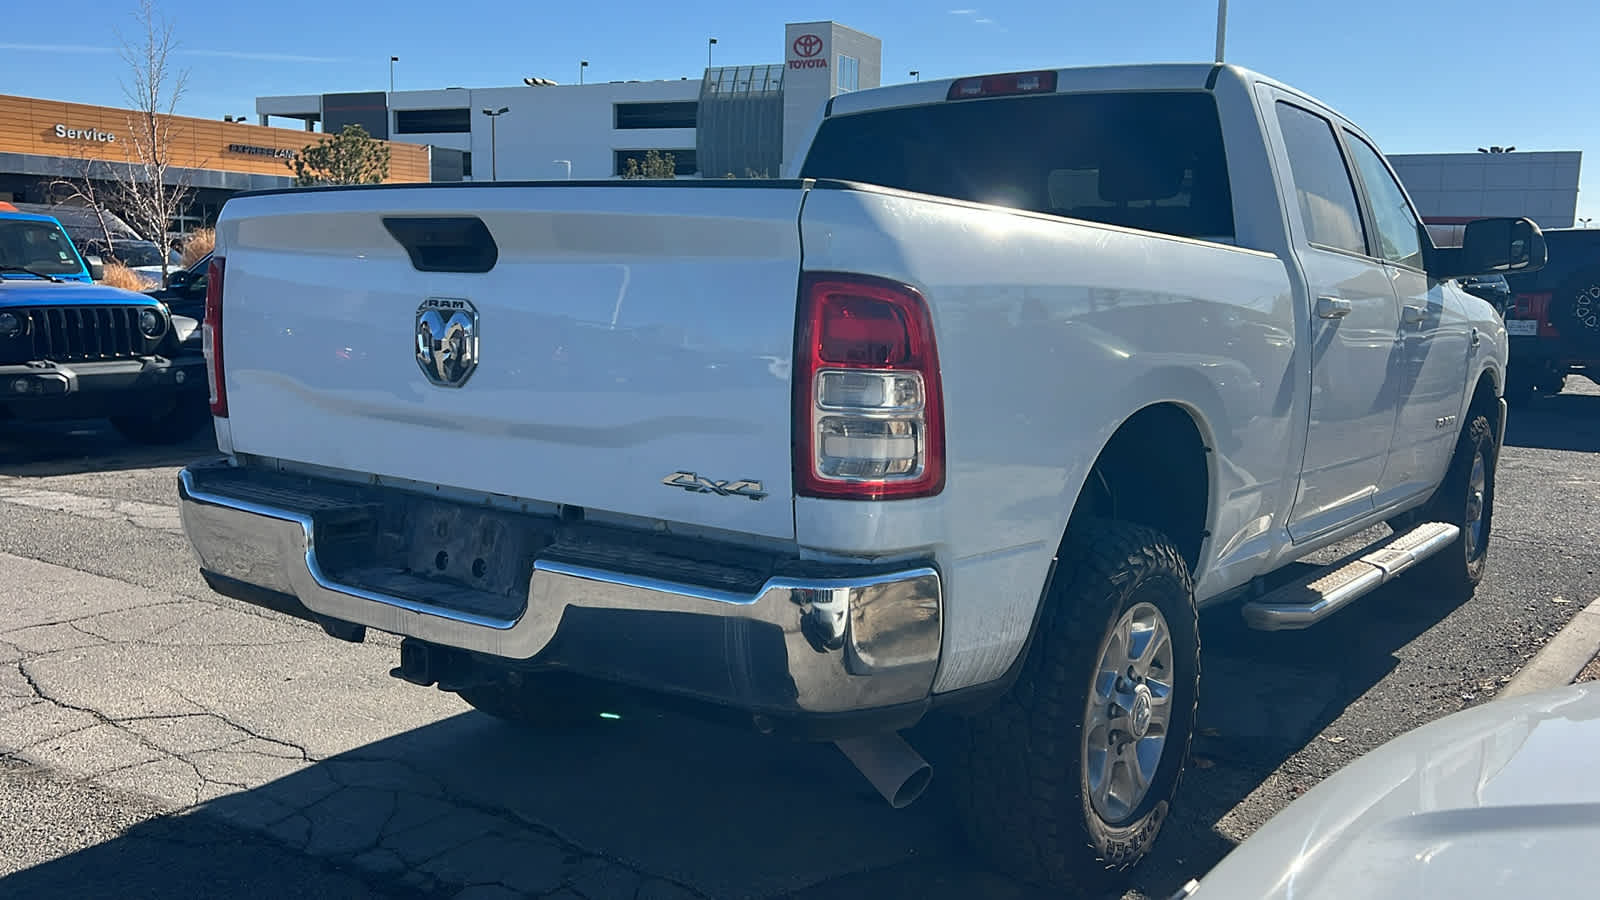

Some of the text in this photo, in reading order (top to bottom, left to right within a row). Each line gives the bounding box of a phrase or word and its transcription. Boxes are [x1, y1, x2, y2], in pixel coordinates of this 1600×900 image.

[788, 59, 828, 69] TOYOTA
[55, 123, 115, 142] Service
[428, 299, 464, 309] RAM
